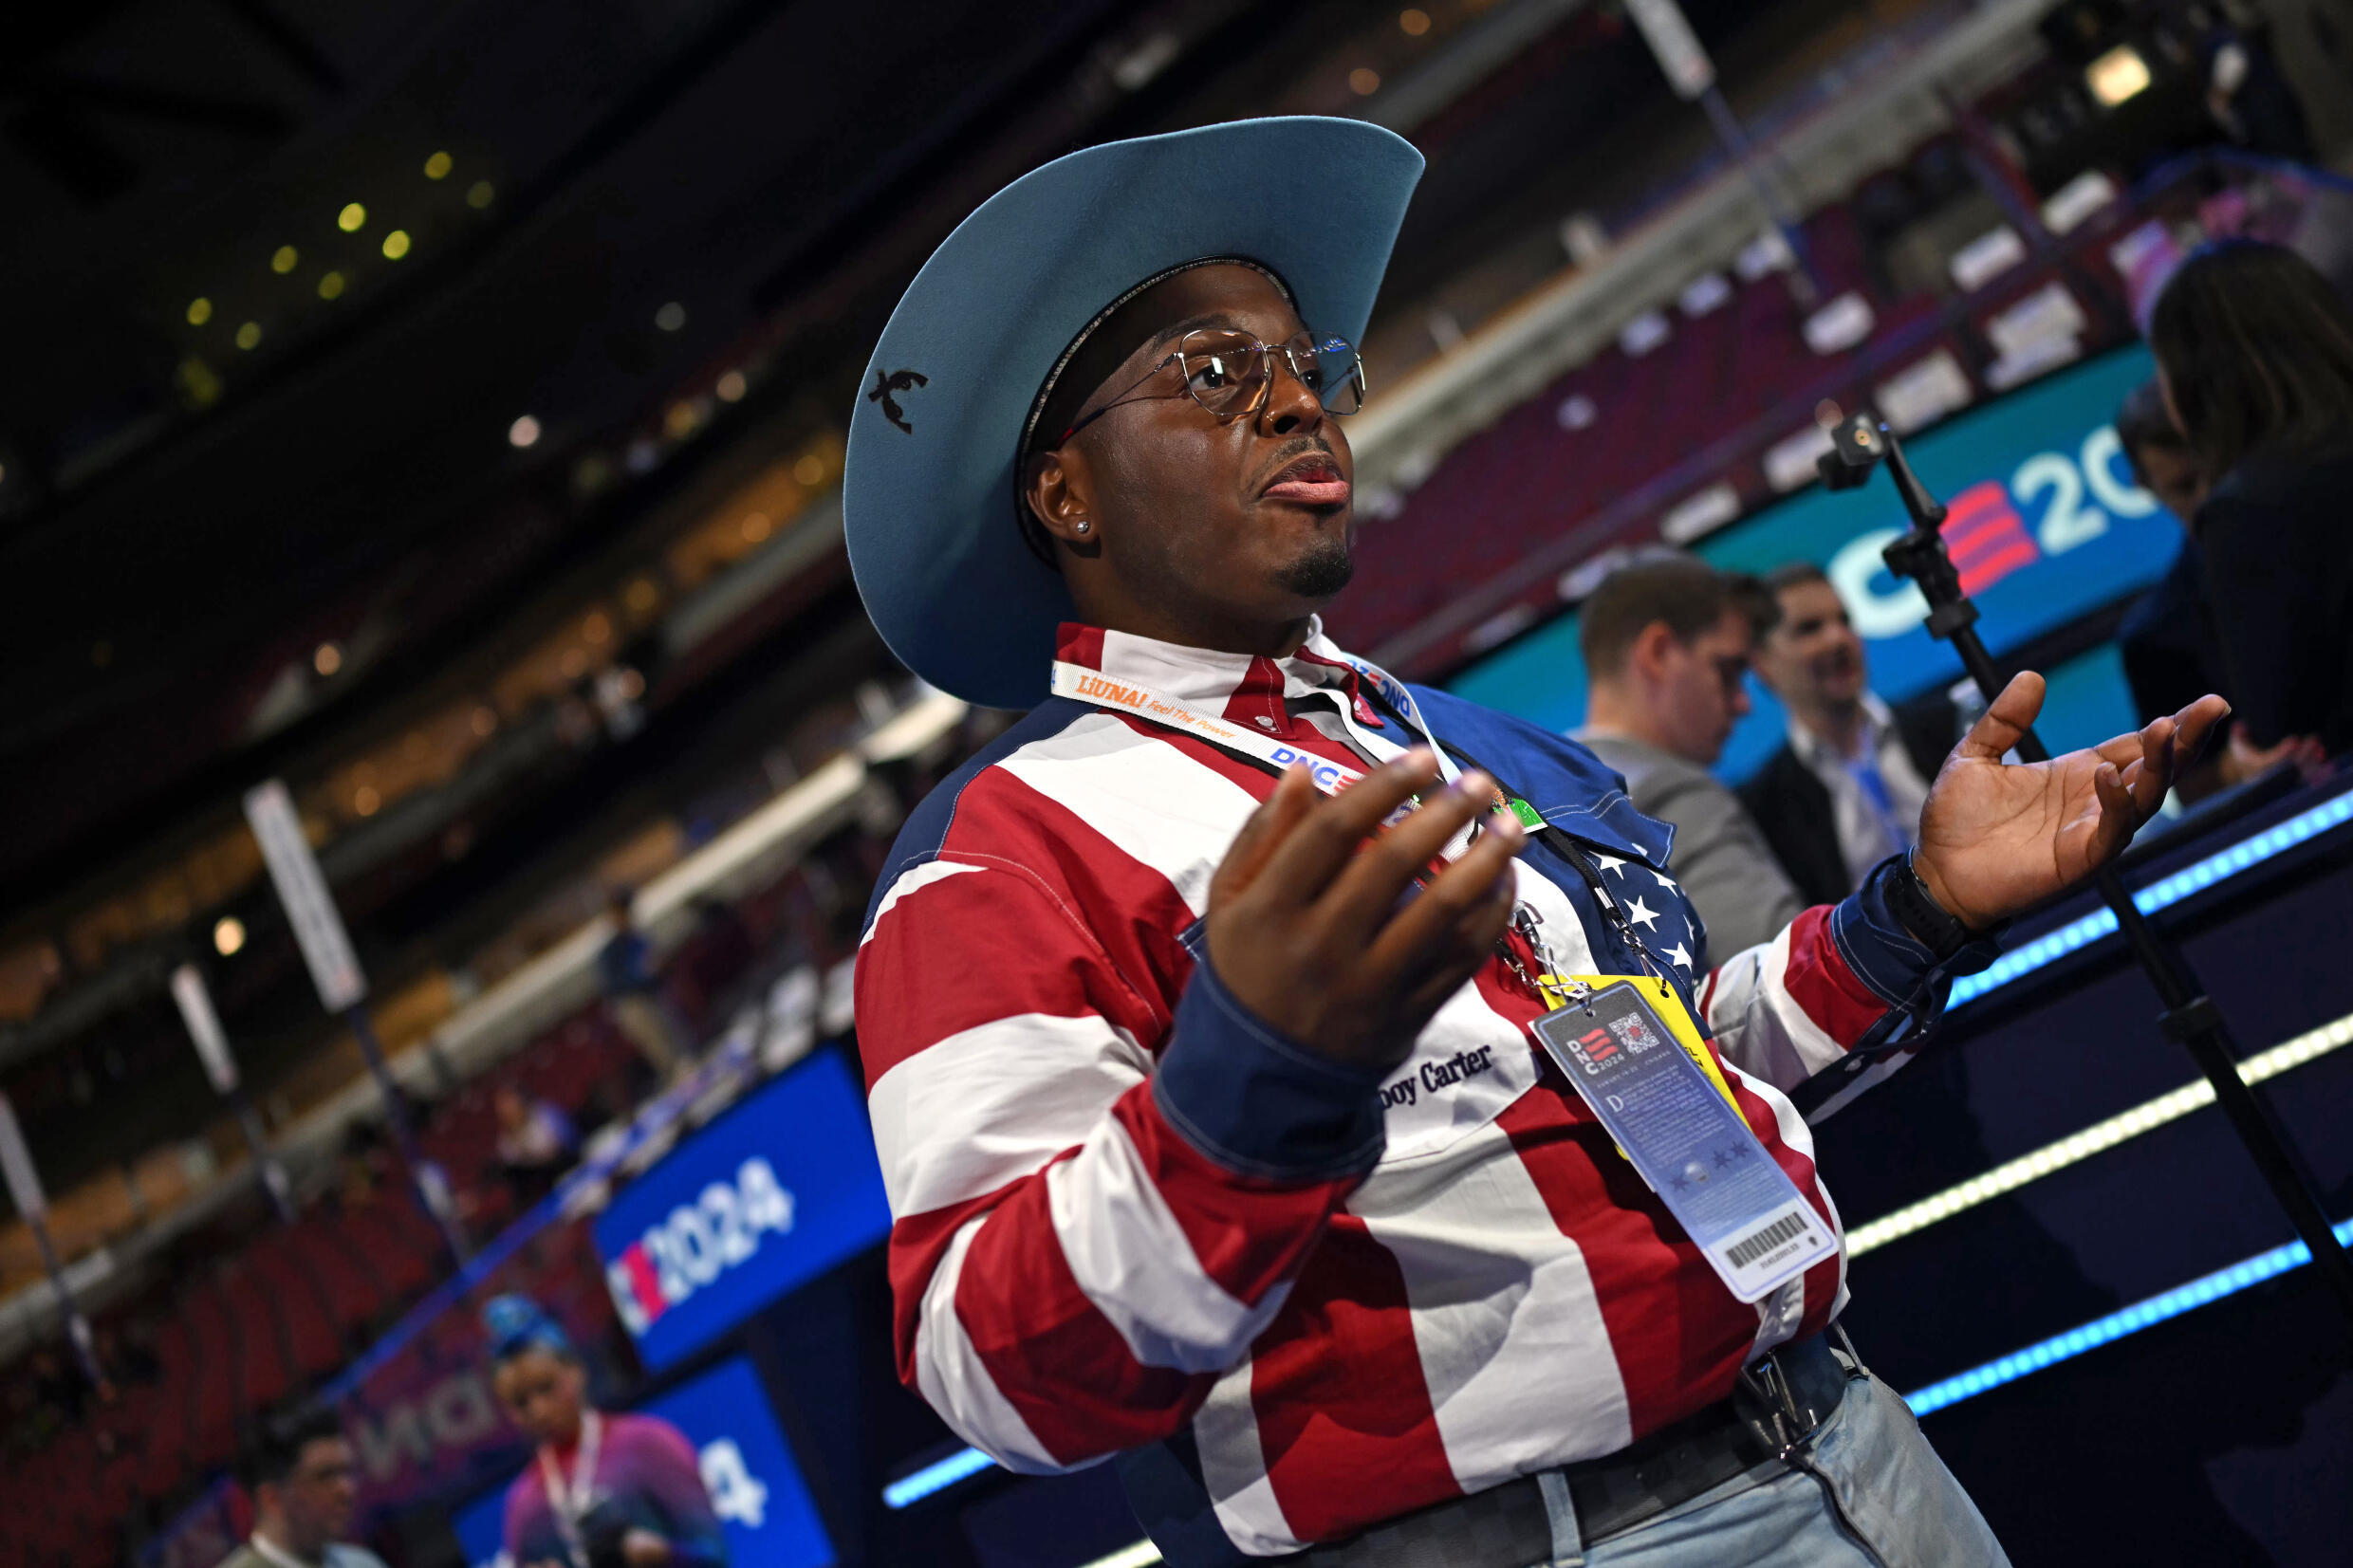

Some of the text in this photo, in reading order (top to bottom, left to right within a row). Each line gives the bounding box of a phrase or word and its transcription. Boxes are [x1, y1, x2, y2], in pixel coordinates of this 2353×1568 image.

[1076, 675, 1149, 708] LiUNA!
[1147, 700, 1175, 714] Feel
[1173, 710, 1195, 724] The
[1196, 720, 1236, 738] Power
[1420, 1044, 1491, 1093] Carter
[1566, 1040, 1600, 1075] DNC
[1598, 1053, 1625, 1071] 2024
[642, 1154, 795, 1307] 2024
